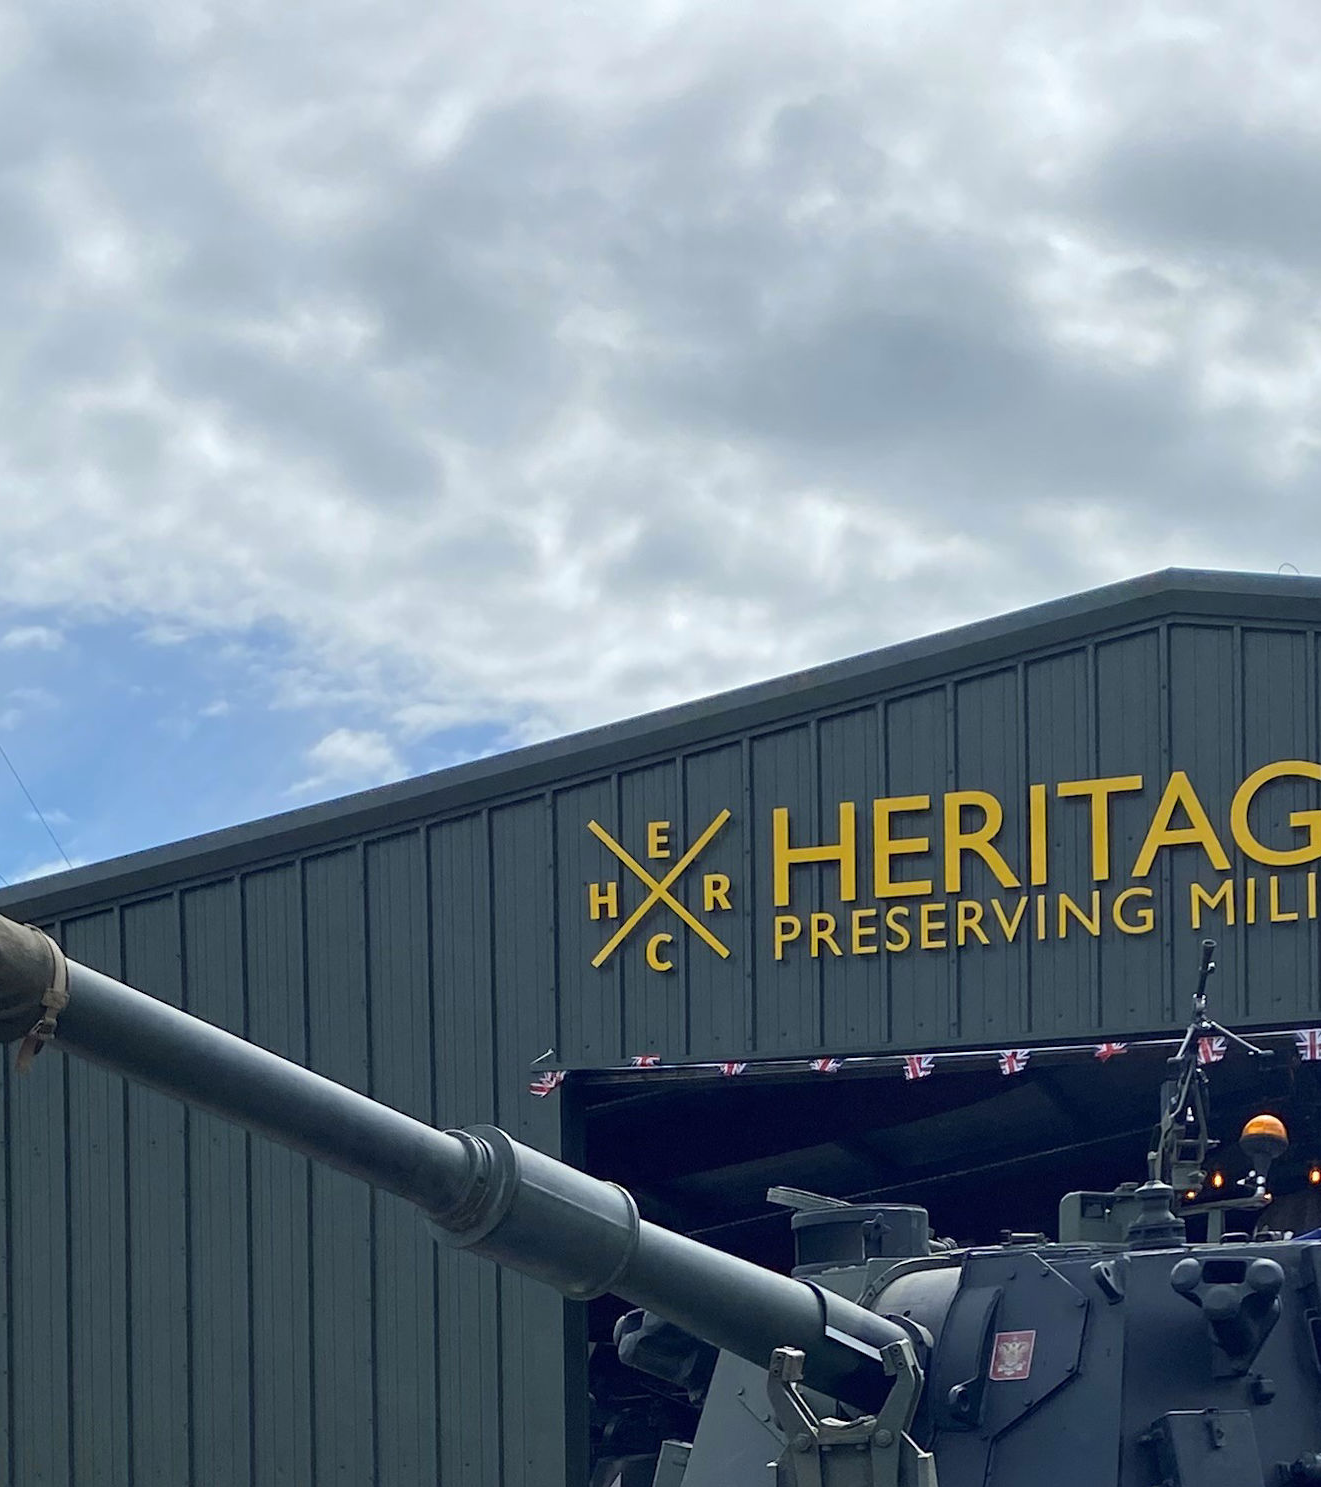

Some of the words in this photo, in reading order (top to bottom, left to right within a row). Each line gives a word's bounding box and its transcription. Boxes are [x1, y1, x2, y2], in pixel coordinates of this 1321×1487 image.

[648, 821, 670, 859] E
[774, 887, 1154, 960] PRESERVING
[646, 934, 672, 972] C
